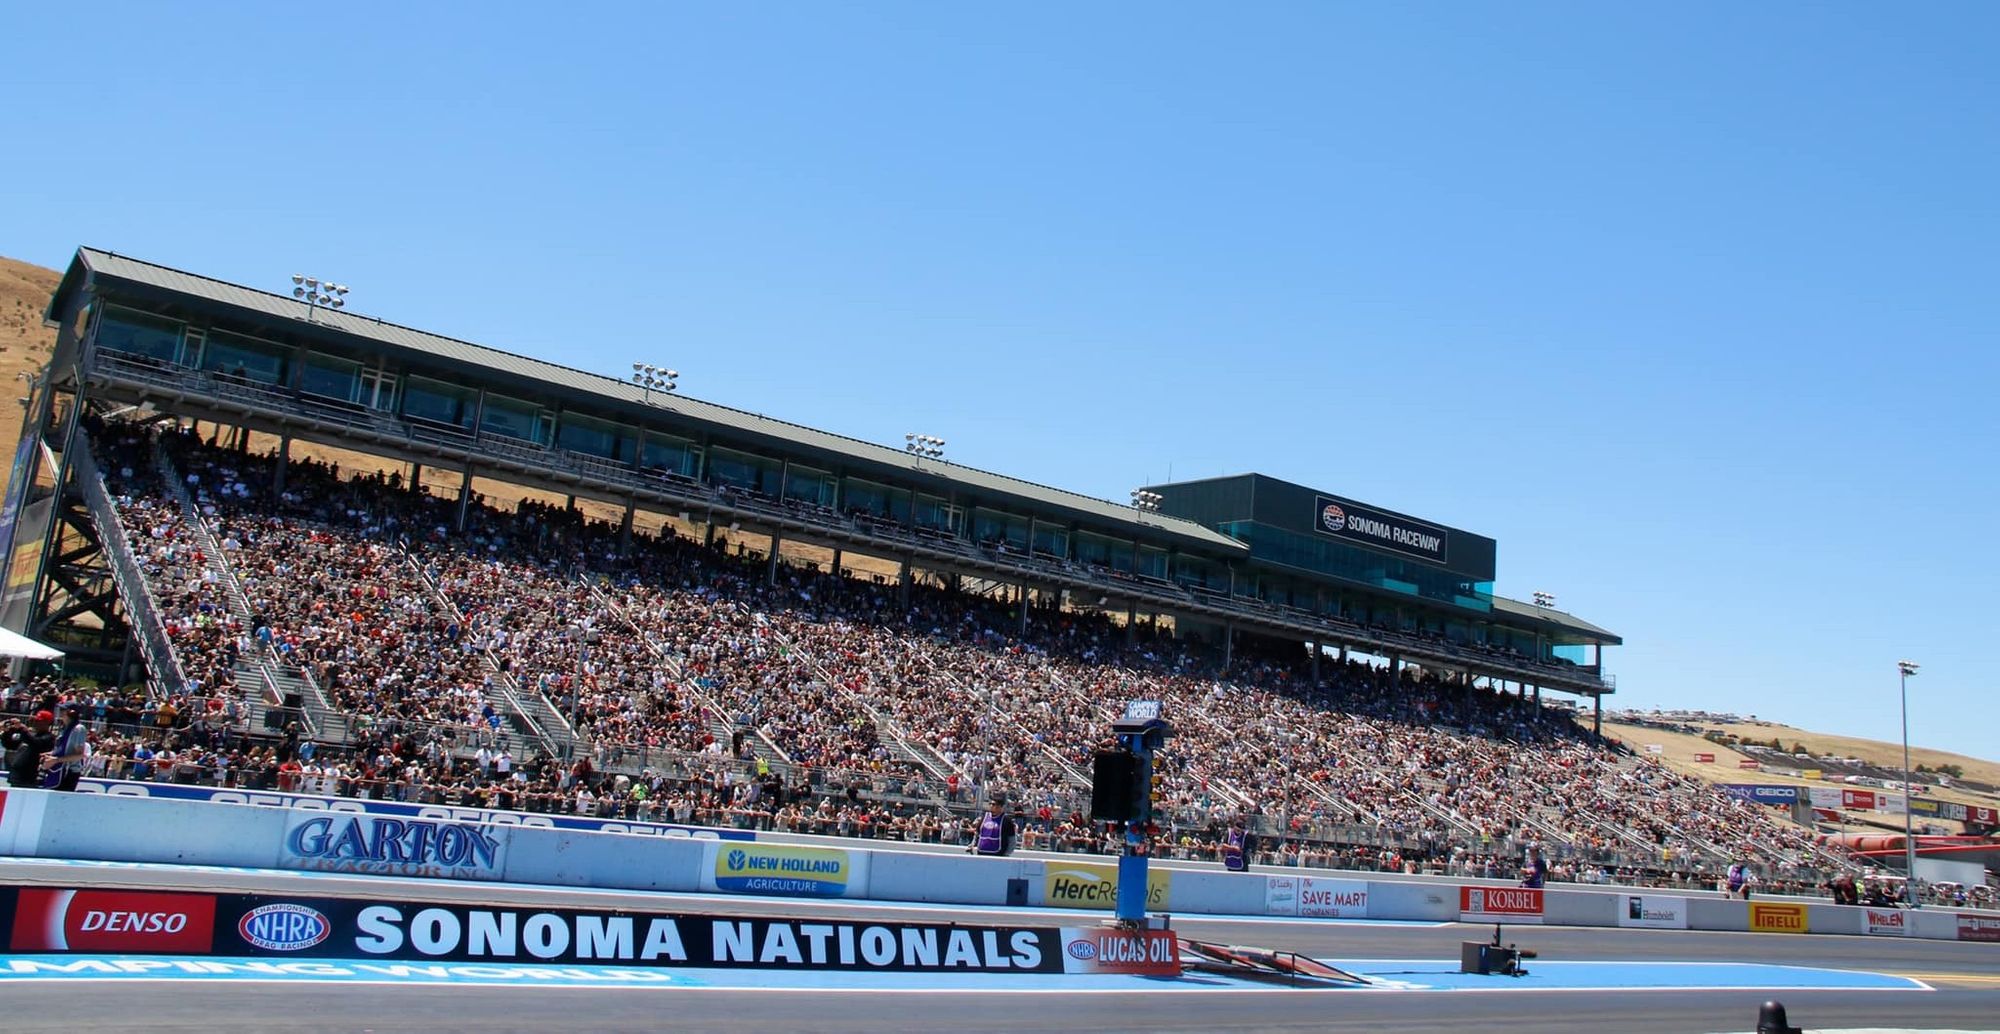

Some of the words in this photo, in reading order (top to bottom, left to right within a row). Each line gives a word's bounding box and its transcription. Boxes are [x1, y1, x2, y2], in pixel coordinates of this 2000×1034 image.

[1348, 515, 1391, 539] SONOMA
[1393, 527, 1440, 552] RACEWAY
[1756, 787, 1795, 797] GEICO
[292, 816, 500, 869] GARTON
[748, 856, 778, 870] NEW
[782, 858, 840, 873] HOLLAND
[746, 879, 817, 892] AGRICULTURE
[1302, 890, 1331, 905] SAVE
[1334, 892, 1366, 906] MART
[1488, 890, 1537, 909] KORBEL
[255, 904, 316, 915] CHAMPIONSHIP
[1755, 905, 1801, 929] PIRELLI
[80, 911, 187, 933] DENSO
[254, 913, 317, 941] NHRA
[355, 906, 687, 960] SONOMA
[712, 920, 1041, 969] NATIONALS
[1070, 942, 1095, 958] NHRA
[1100, 936, 1146, 962] LUCAS
[1151, 937, 1173, 962] OIL
